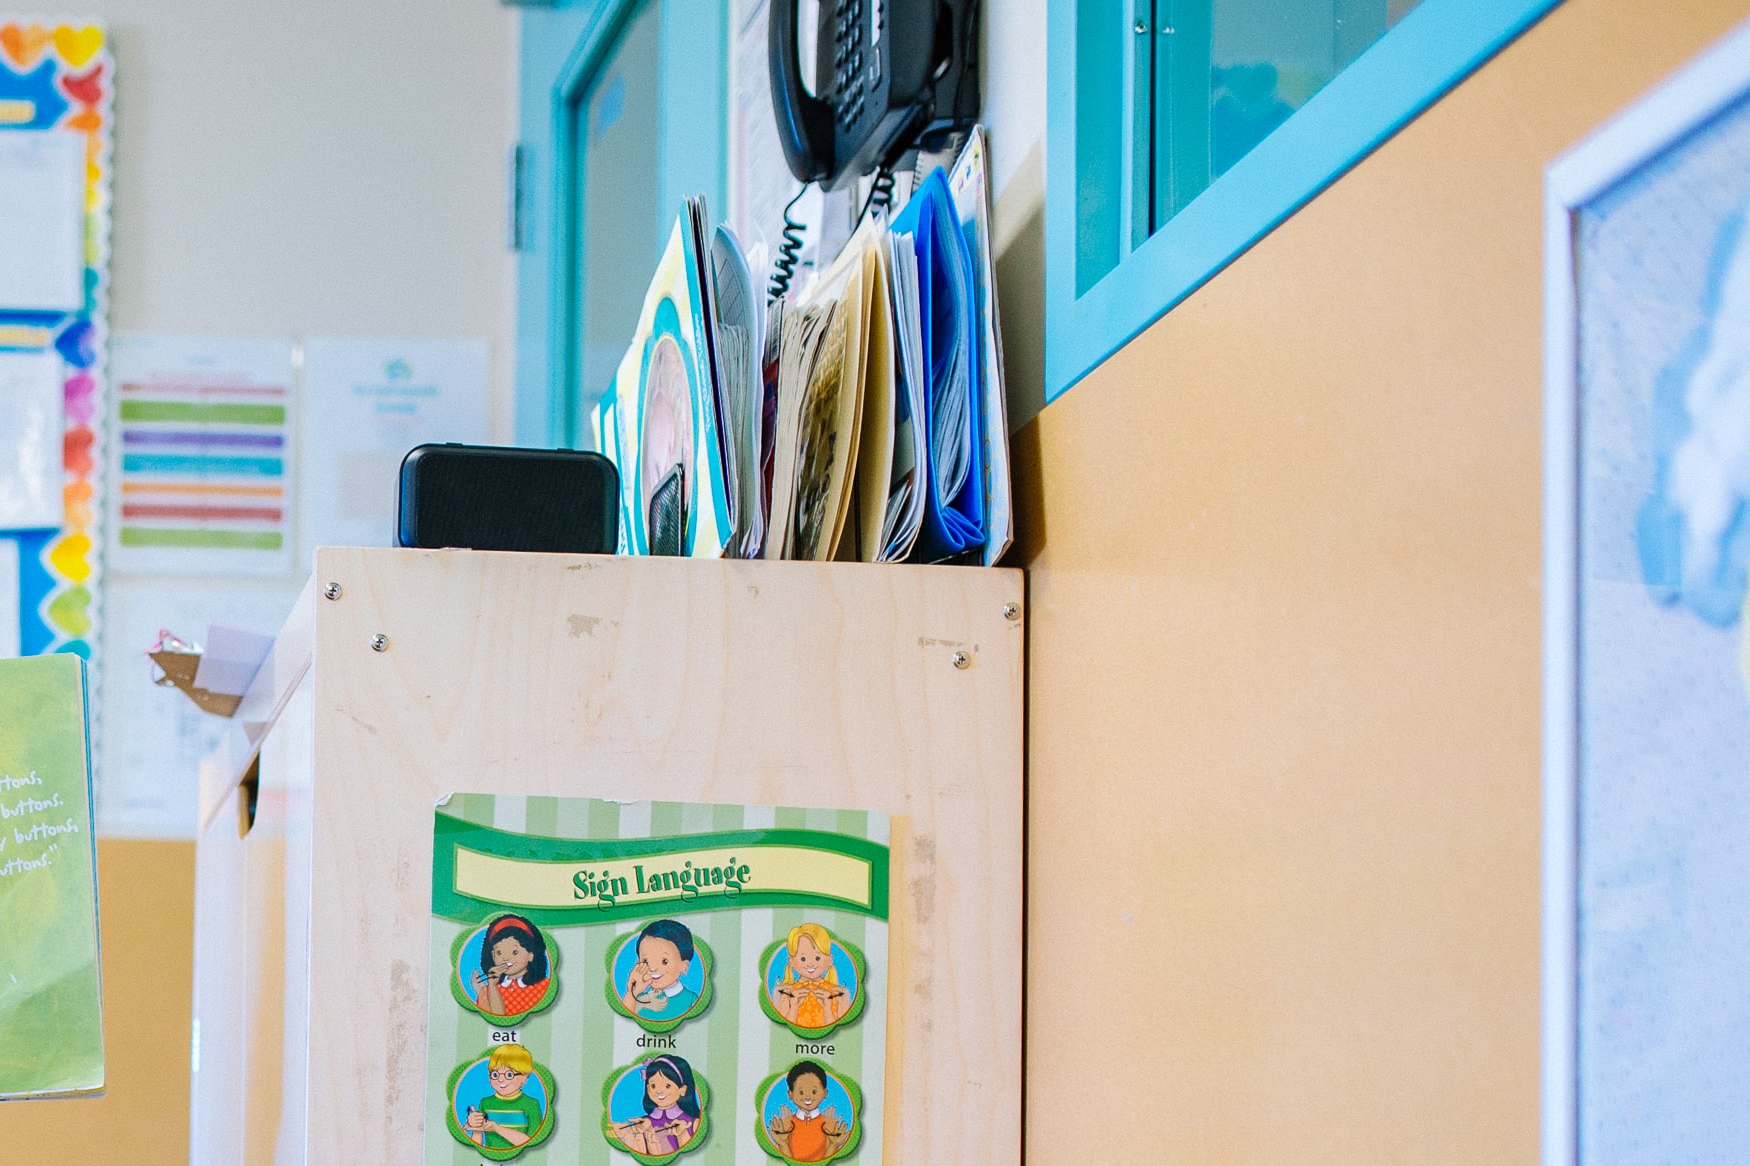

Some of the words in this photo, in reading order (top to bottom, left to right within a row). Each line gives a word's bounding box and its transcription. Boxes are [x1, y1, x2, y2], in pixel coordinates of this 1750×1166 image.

[0, 793, 64, 819] buttons.
[14, 818, 79, 845] buttons,
[572, 869, 629, 913] Sign
[633, 856, 752, 904] Language
[492, 1030, 517, 1043] eat
[635, 1033, 677, 1049] drink
[795, 1043, 836, 1056] more
